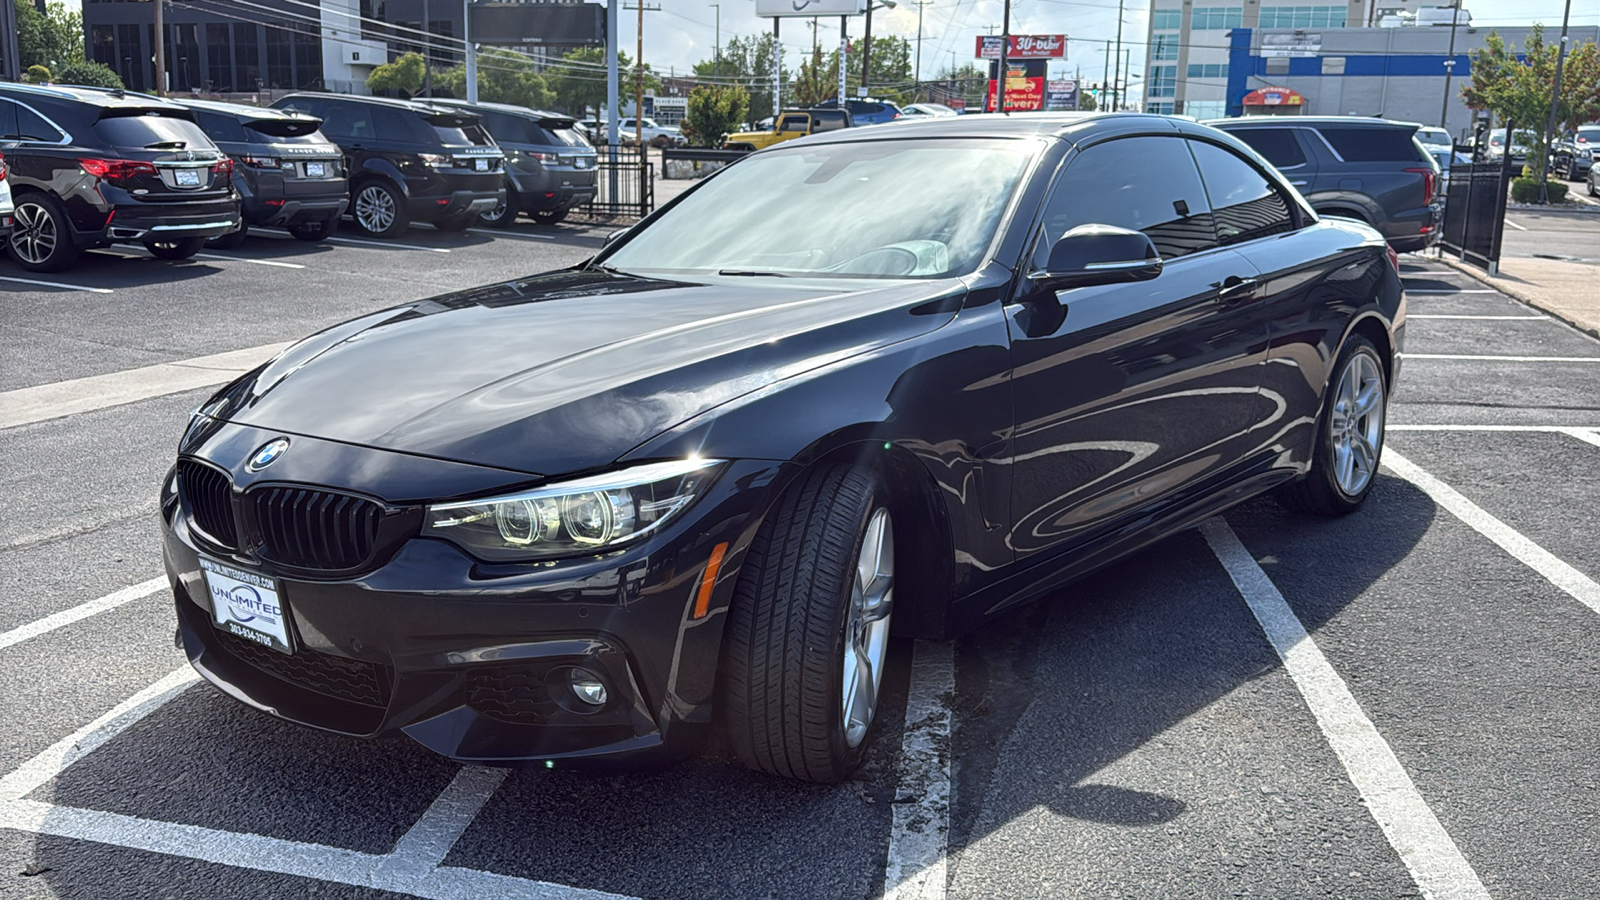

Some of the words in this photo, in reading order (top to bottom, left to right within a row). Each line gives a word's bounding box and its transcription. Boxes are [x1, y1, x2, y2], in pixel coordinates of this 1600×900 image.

[1257, 86, 1290, 95] ENTRANCE
[990, 99, 1040, 110] Dlivery
[211, 585, 282, 616] UNLIMITED
[228, 623, 273, 647] 303-934-3705
